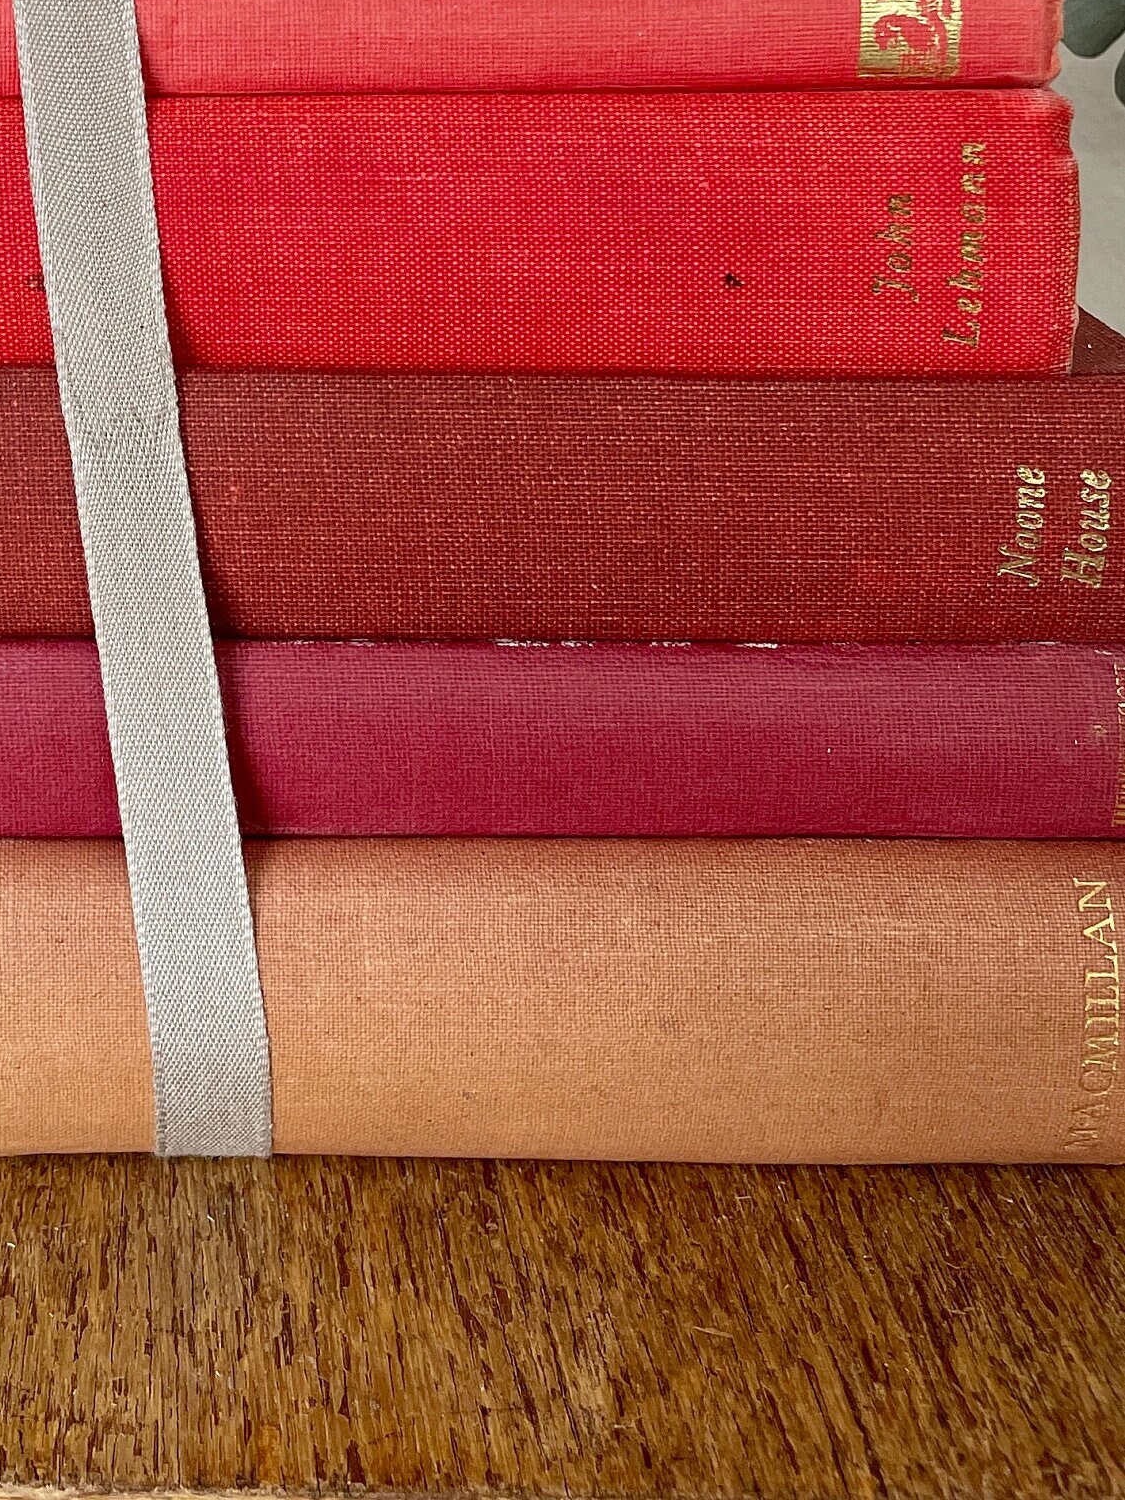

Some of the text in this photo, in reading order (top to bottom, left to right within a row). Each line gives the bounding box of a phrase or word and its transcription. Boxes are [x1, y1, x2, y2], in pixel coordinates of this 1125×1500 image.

[871, 194, 918, 303] John
[943, 141, 987, 348] Lehmann
[997, 465, 1045, 587] Noone
[1060, 469, 1112, 589] House
[1064, 877, 1120, 1151] MACMILLAN
